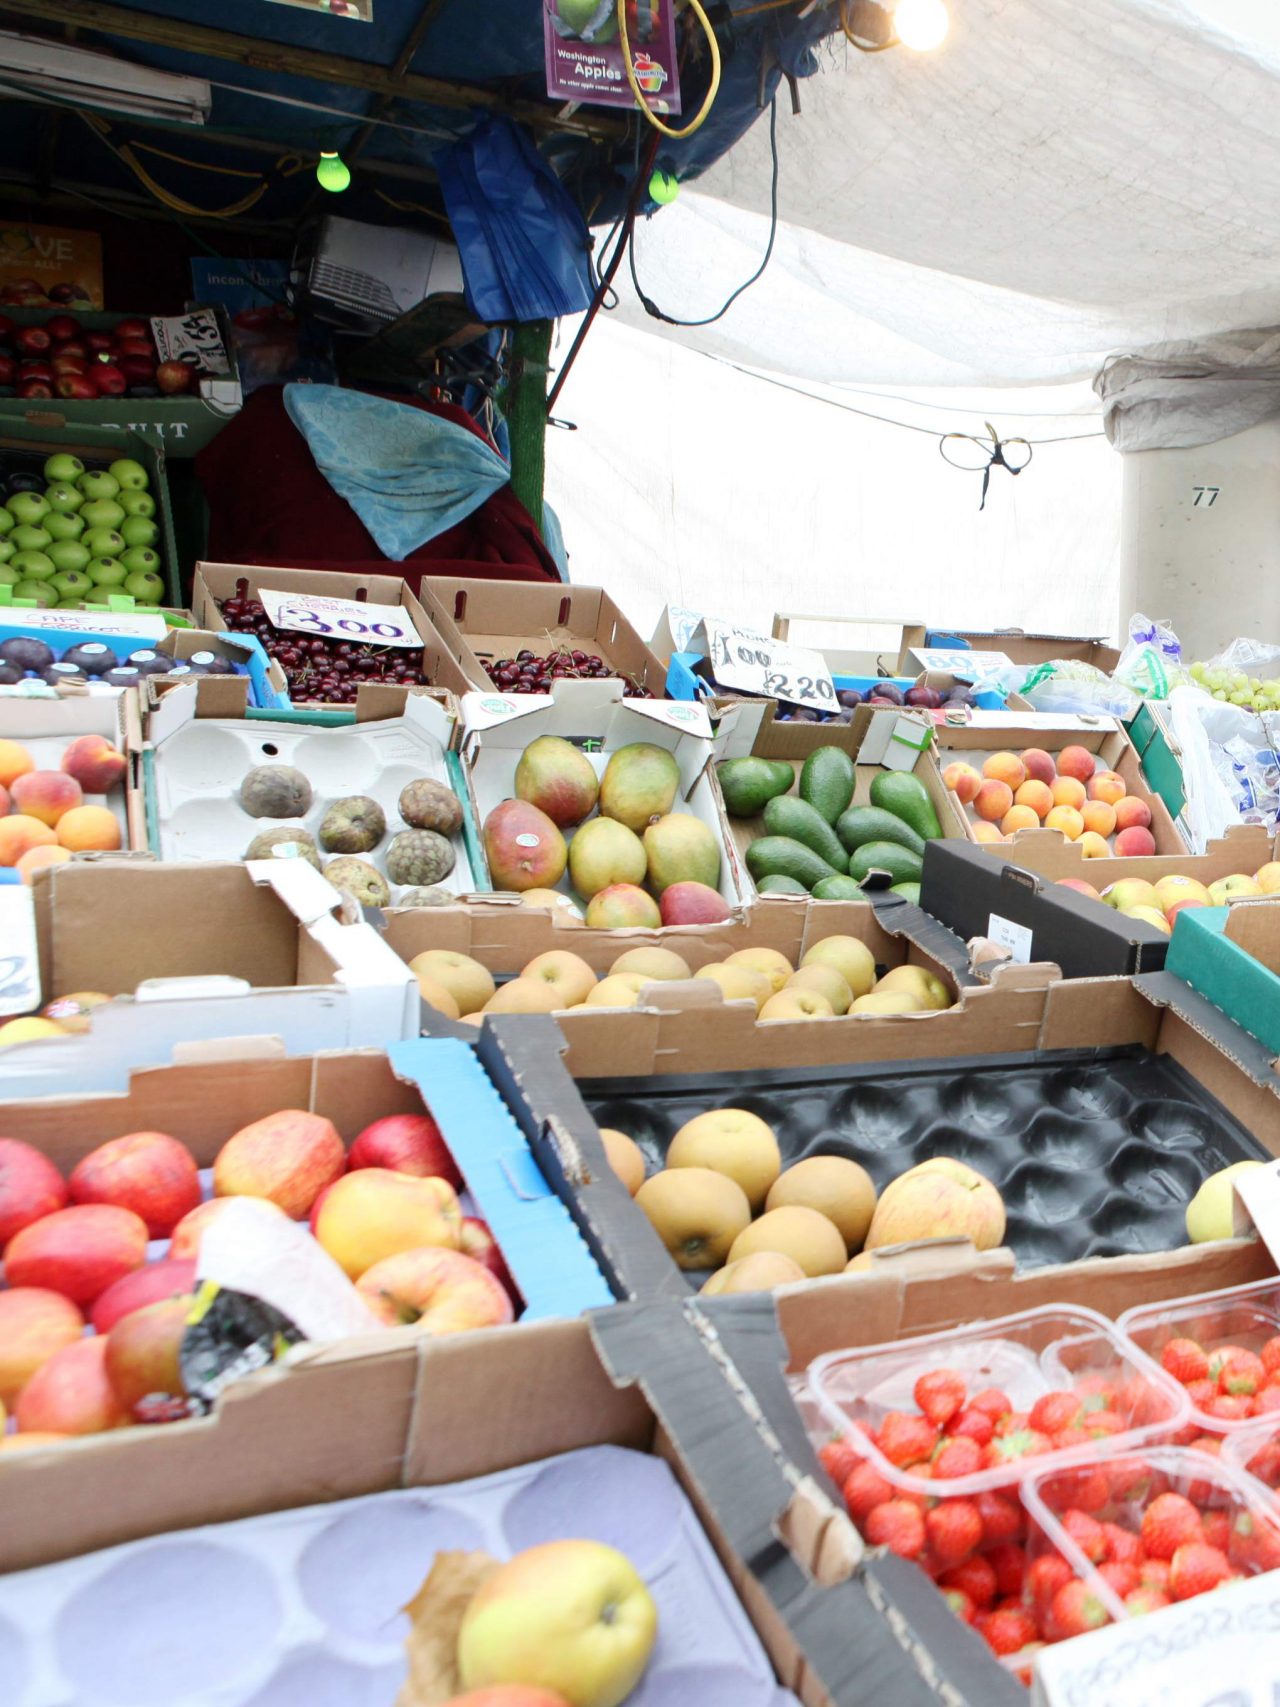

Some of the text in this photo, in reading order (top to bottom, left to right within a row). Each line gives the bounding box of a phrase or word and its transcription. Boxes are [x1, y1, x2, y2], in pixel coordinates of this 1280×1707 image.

[557, 49, 607, 65] Washington
[574, 61, 623, 81] Apples
[1192, 486, 1220, 507] 77
